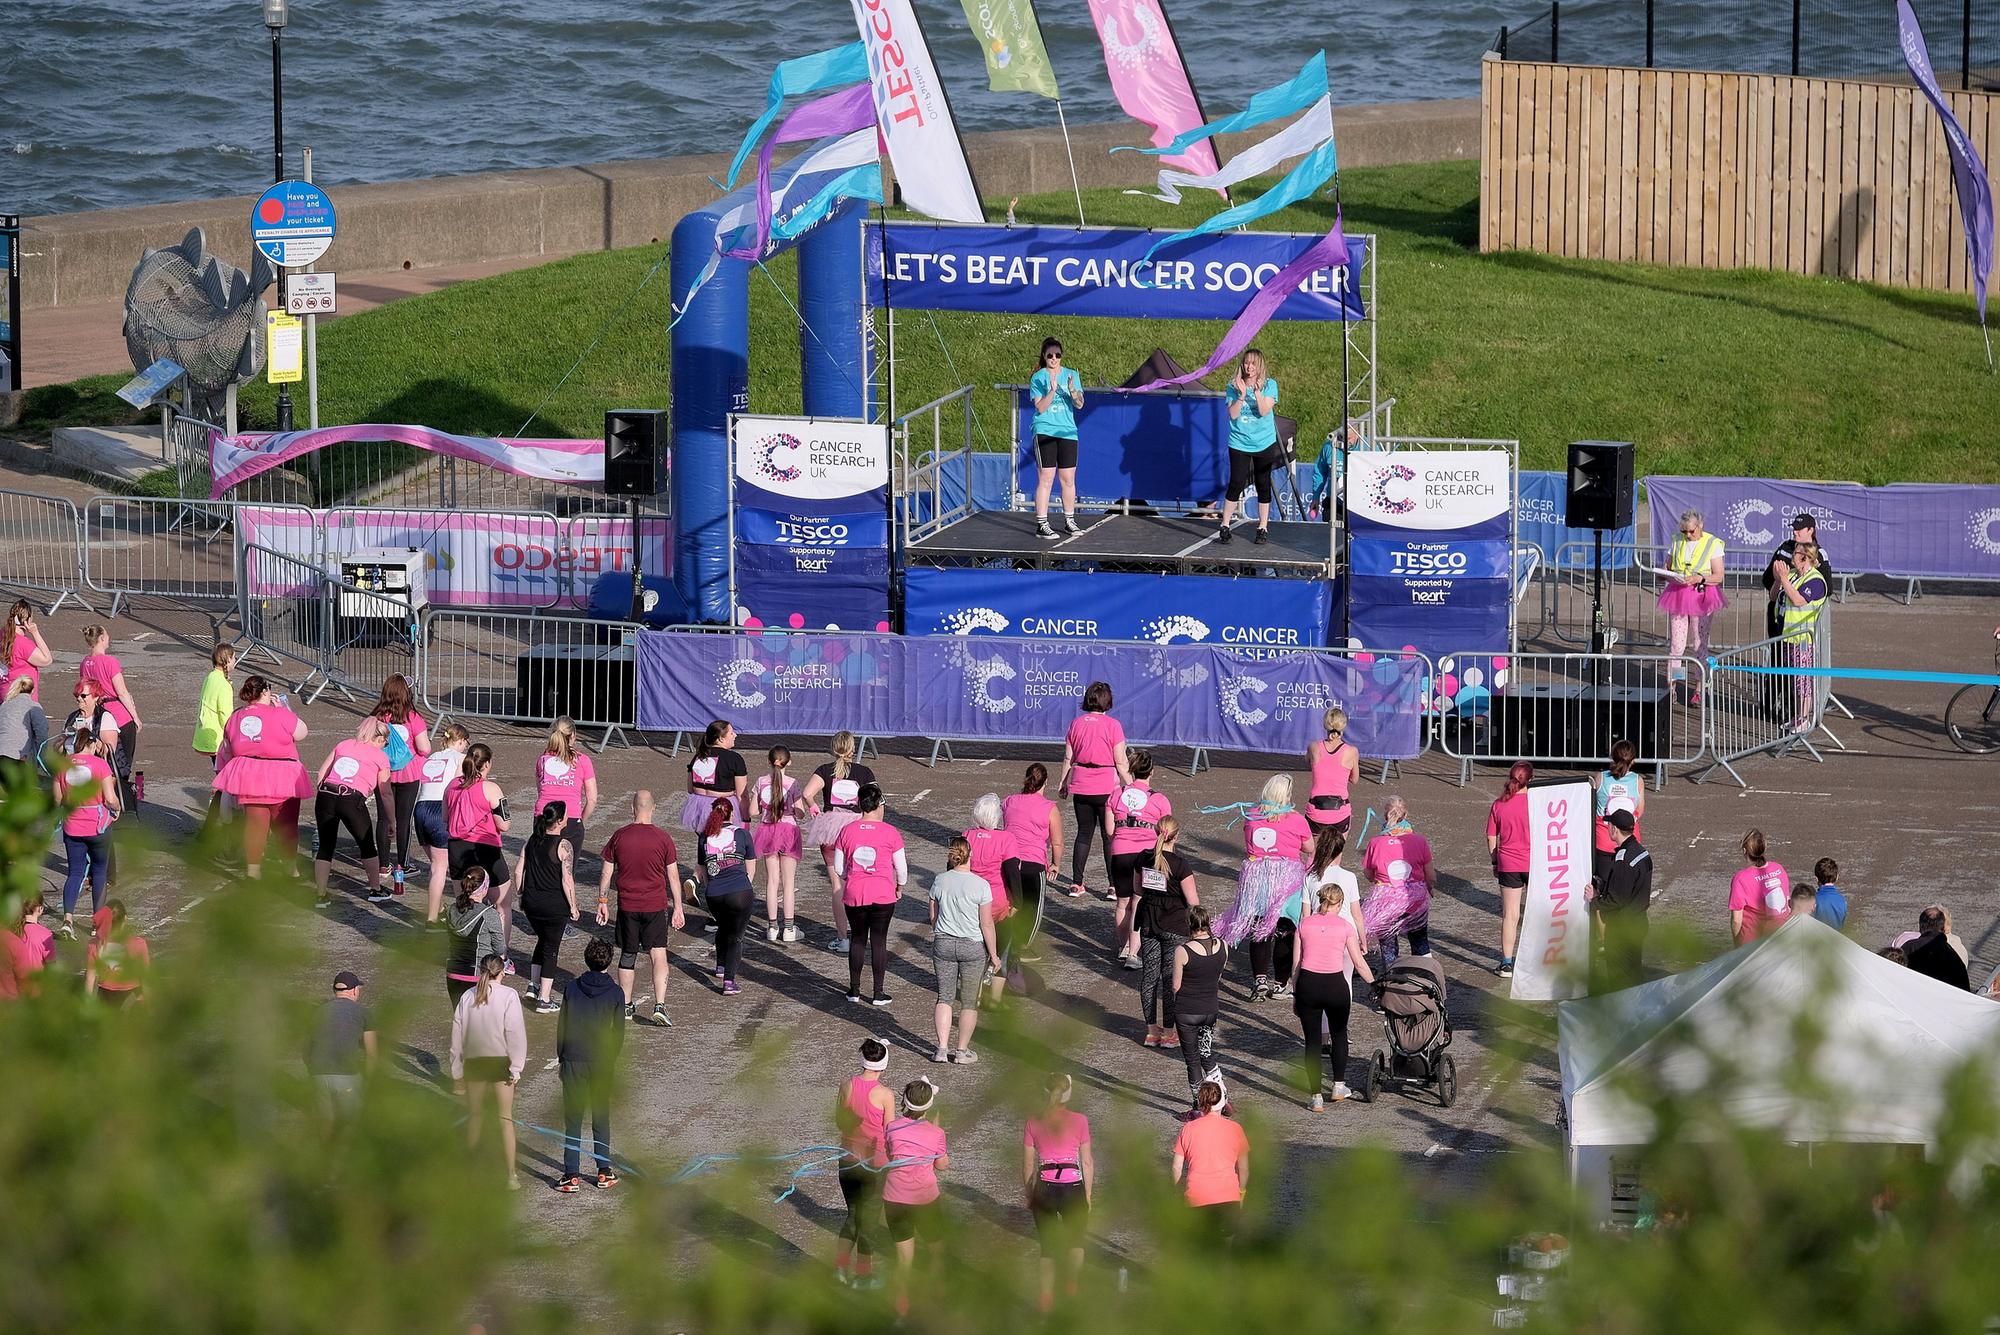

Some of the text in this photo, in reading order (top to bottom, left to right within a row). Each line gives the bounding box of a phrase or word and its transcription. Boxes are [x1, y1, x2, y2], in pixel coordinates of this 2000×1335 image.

[305, 193, 319, 201] you
[967, 254, 1048, 286] BEAT
[1055, 257, 1196, 291] CANCER
[809, 440, 862, 454] CANCER
[809, 453, 876, 468] RESEARCH
[809, 467, 827, 479] UK
[1425, 470, 1480, 482] CANCER
[1425, 483, 1494, 496] RESEARCH
[1425, 499, 1444, 509] UK
[1518, 510, 1566, 525] SEARCH
[1781, 505, 1833, 518] CANCER
[790, 514, 830, 524] Our Partner
[775, 520, 849, 539] TESCO
[789, 546, 836, 557] Supported by
[1407, 542, 1449, 551] Our Partner
[795, 556, 828, 570] heart
[1390, 551, 1467, 569] TESCO
[1404, 578, 1453, 588] Supported by
[1412, 588, 1445, 601] heart
[1021, 617, 1098, 636] CANCER
[1221, 626, 1299, 645] CANCER
[774, 664, 828, 677] CANCER
[1024, 671, 1080, 683] CANCER
[774, 677, 842, 690] RESEARCH
[1276, 682, 1330, 696] CANCER
[774, 692, 792, 703] UK
[1024, 698, 1042, 709] UK
[1274, 709, 1293, 721] UK
[1542, 799, 1570, 966] RUNNERS
